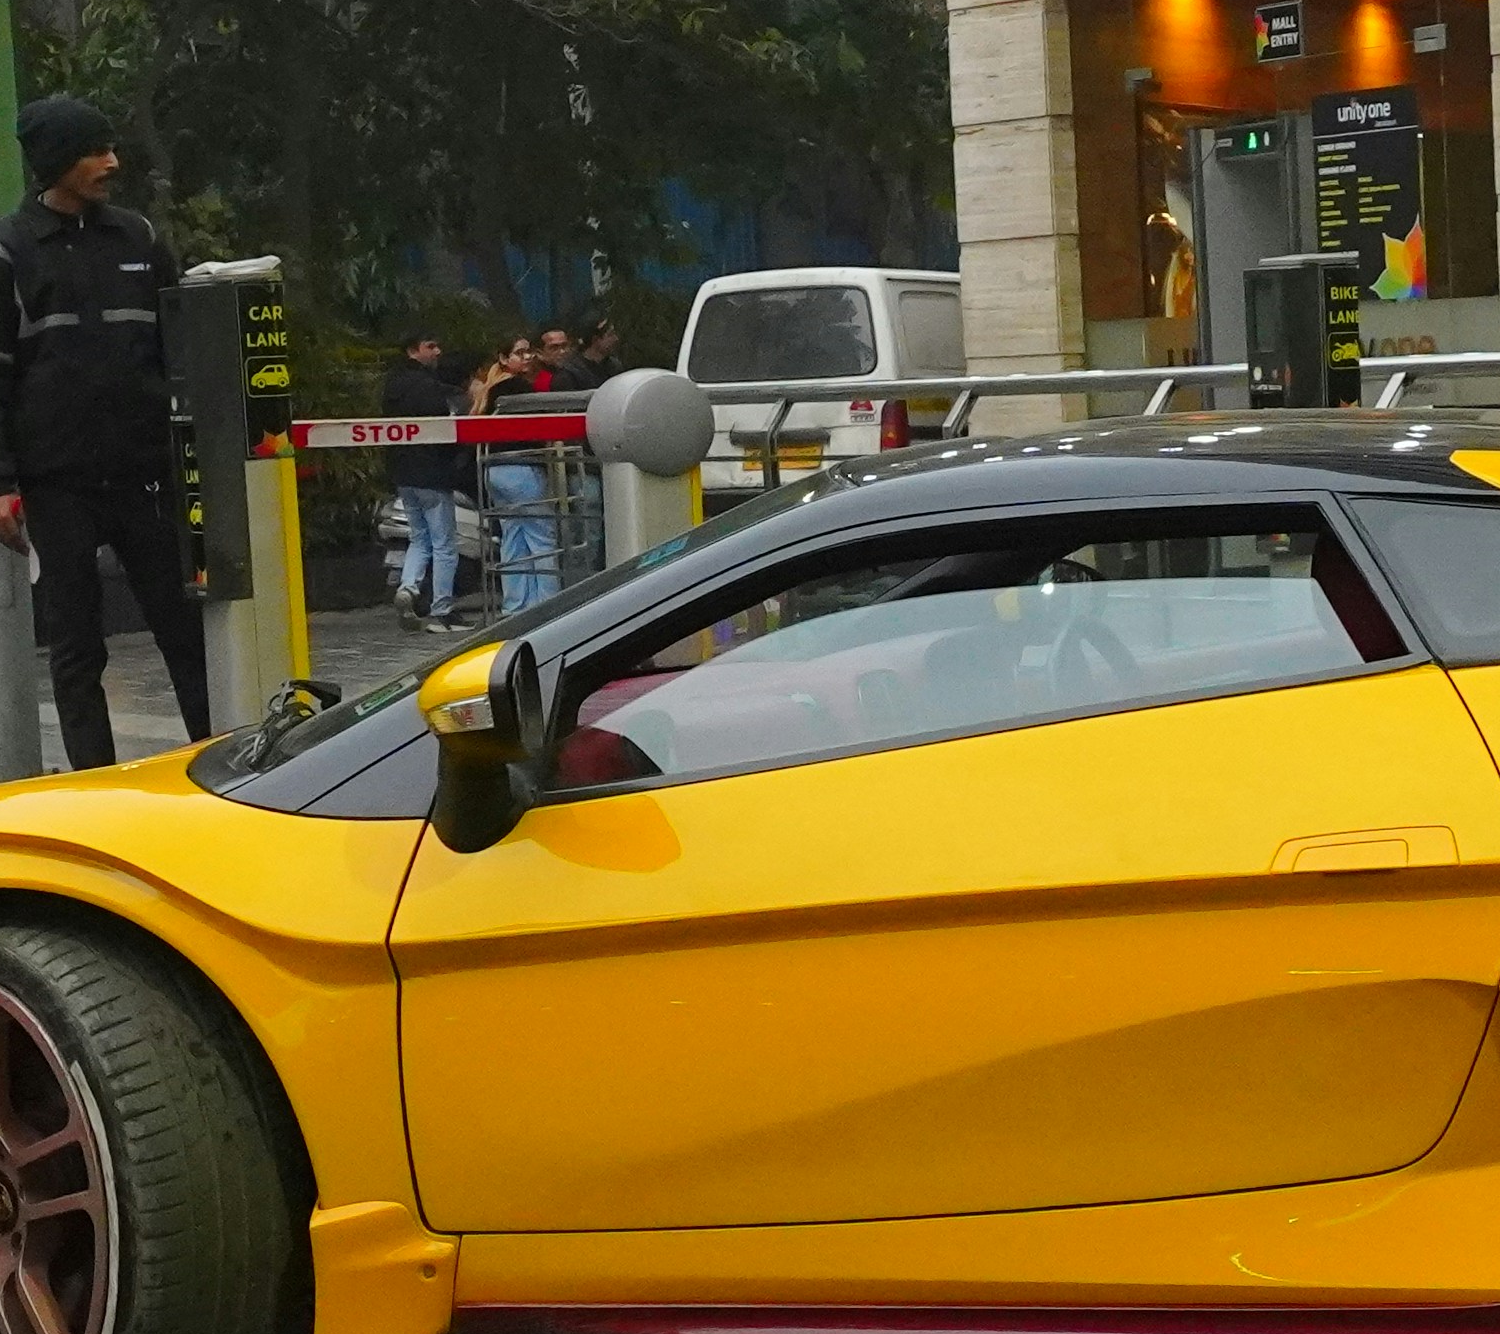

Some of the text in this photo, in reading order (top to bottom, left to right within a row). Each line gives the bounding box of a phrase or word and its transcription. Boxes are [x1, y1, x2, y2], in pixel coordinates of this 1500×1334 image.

[1271, 15, 1297, 31] MALL
[1270, 31, 1299, 48] ENTRY
[1330, 286, 1359, 300] BIKE
[249, 305, 284, 322] CAR
[246, 332, 288, 349] LANE
[351, 424, 420, 444] STOP
